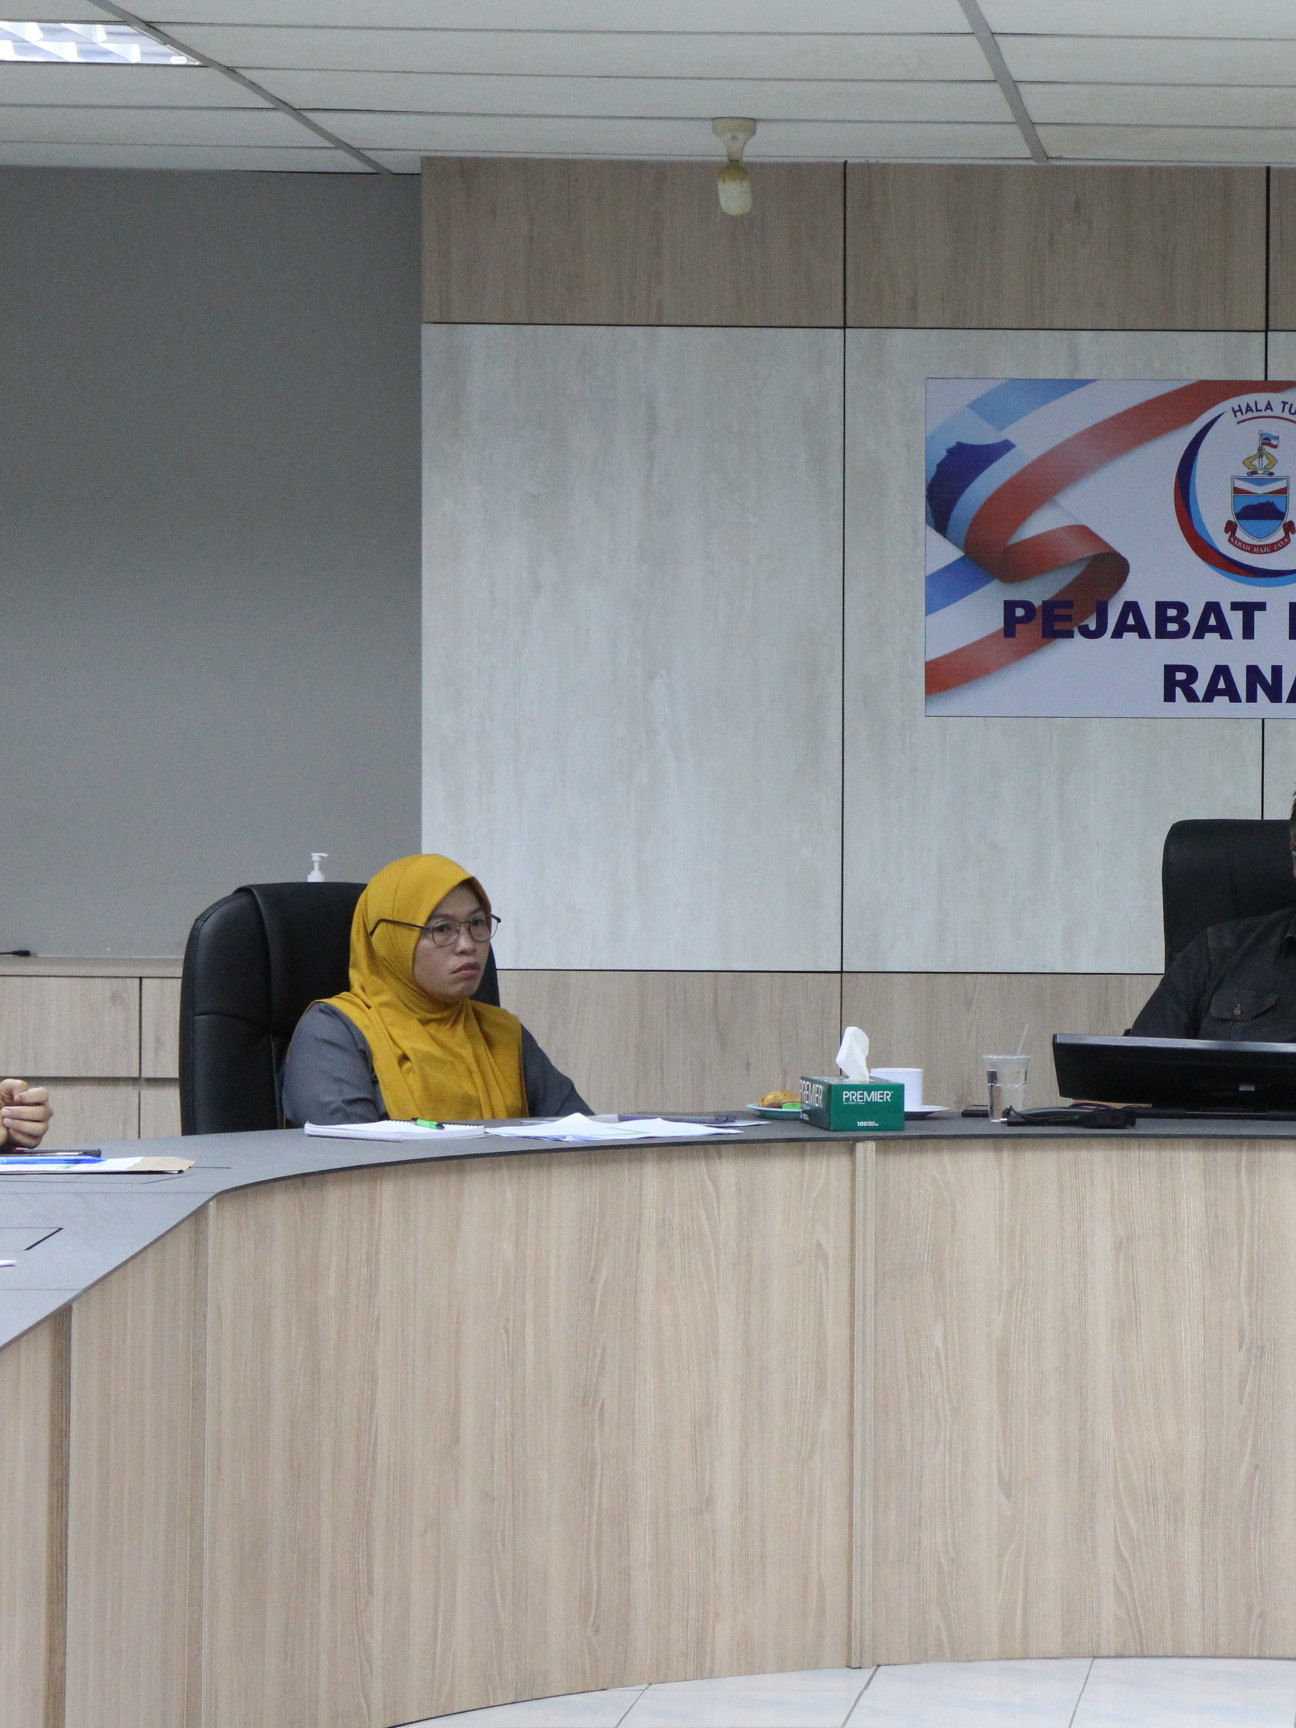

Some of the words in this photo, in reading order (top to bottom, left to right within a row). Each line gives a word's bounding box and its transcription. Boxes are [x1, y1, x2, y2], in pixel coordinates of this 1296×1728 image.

[1231, 400, 1274, 418] HALA
[1003, 599, 1267, 640] PEJABAT
[842, 1090, 892, 1102] PREMIER
